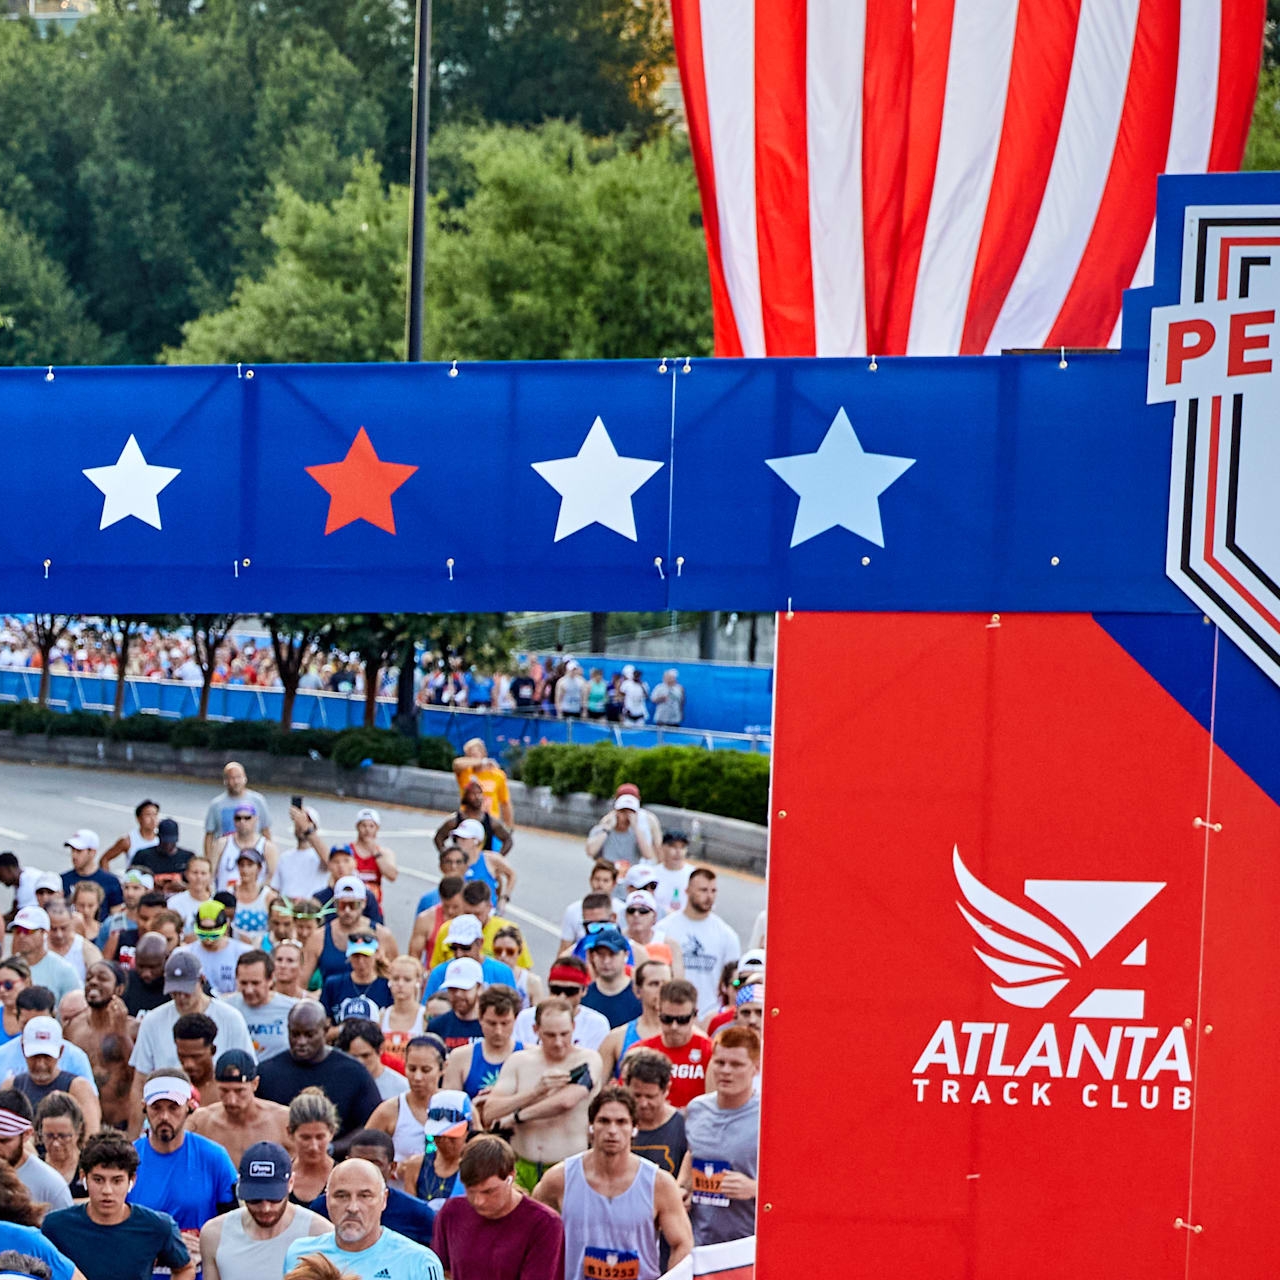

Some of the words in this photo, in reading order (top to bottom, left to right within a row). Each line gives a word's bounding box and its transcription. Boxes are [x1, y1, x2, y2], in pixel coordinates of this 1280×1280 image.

[1165, 310, 1276, 387] PE
[912, 1020, 1192, 1082] ATLANTA
[913, 1078, 1052, 1107] TRACK
[1083, 1083, 1192, 1110] CLUB
